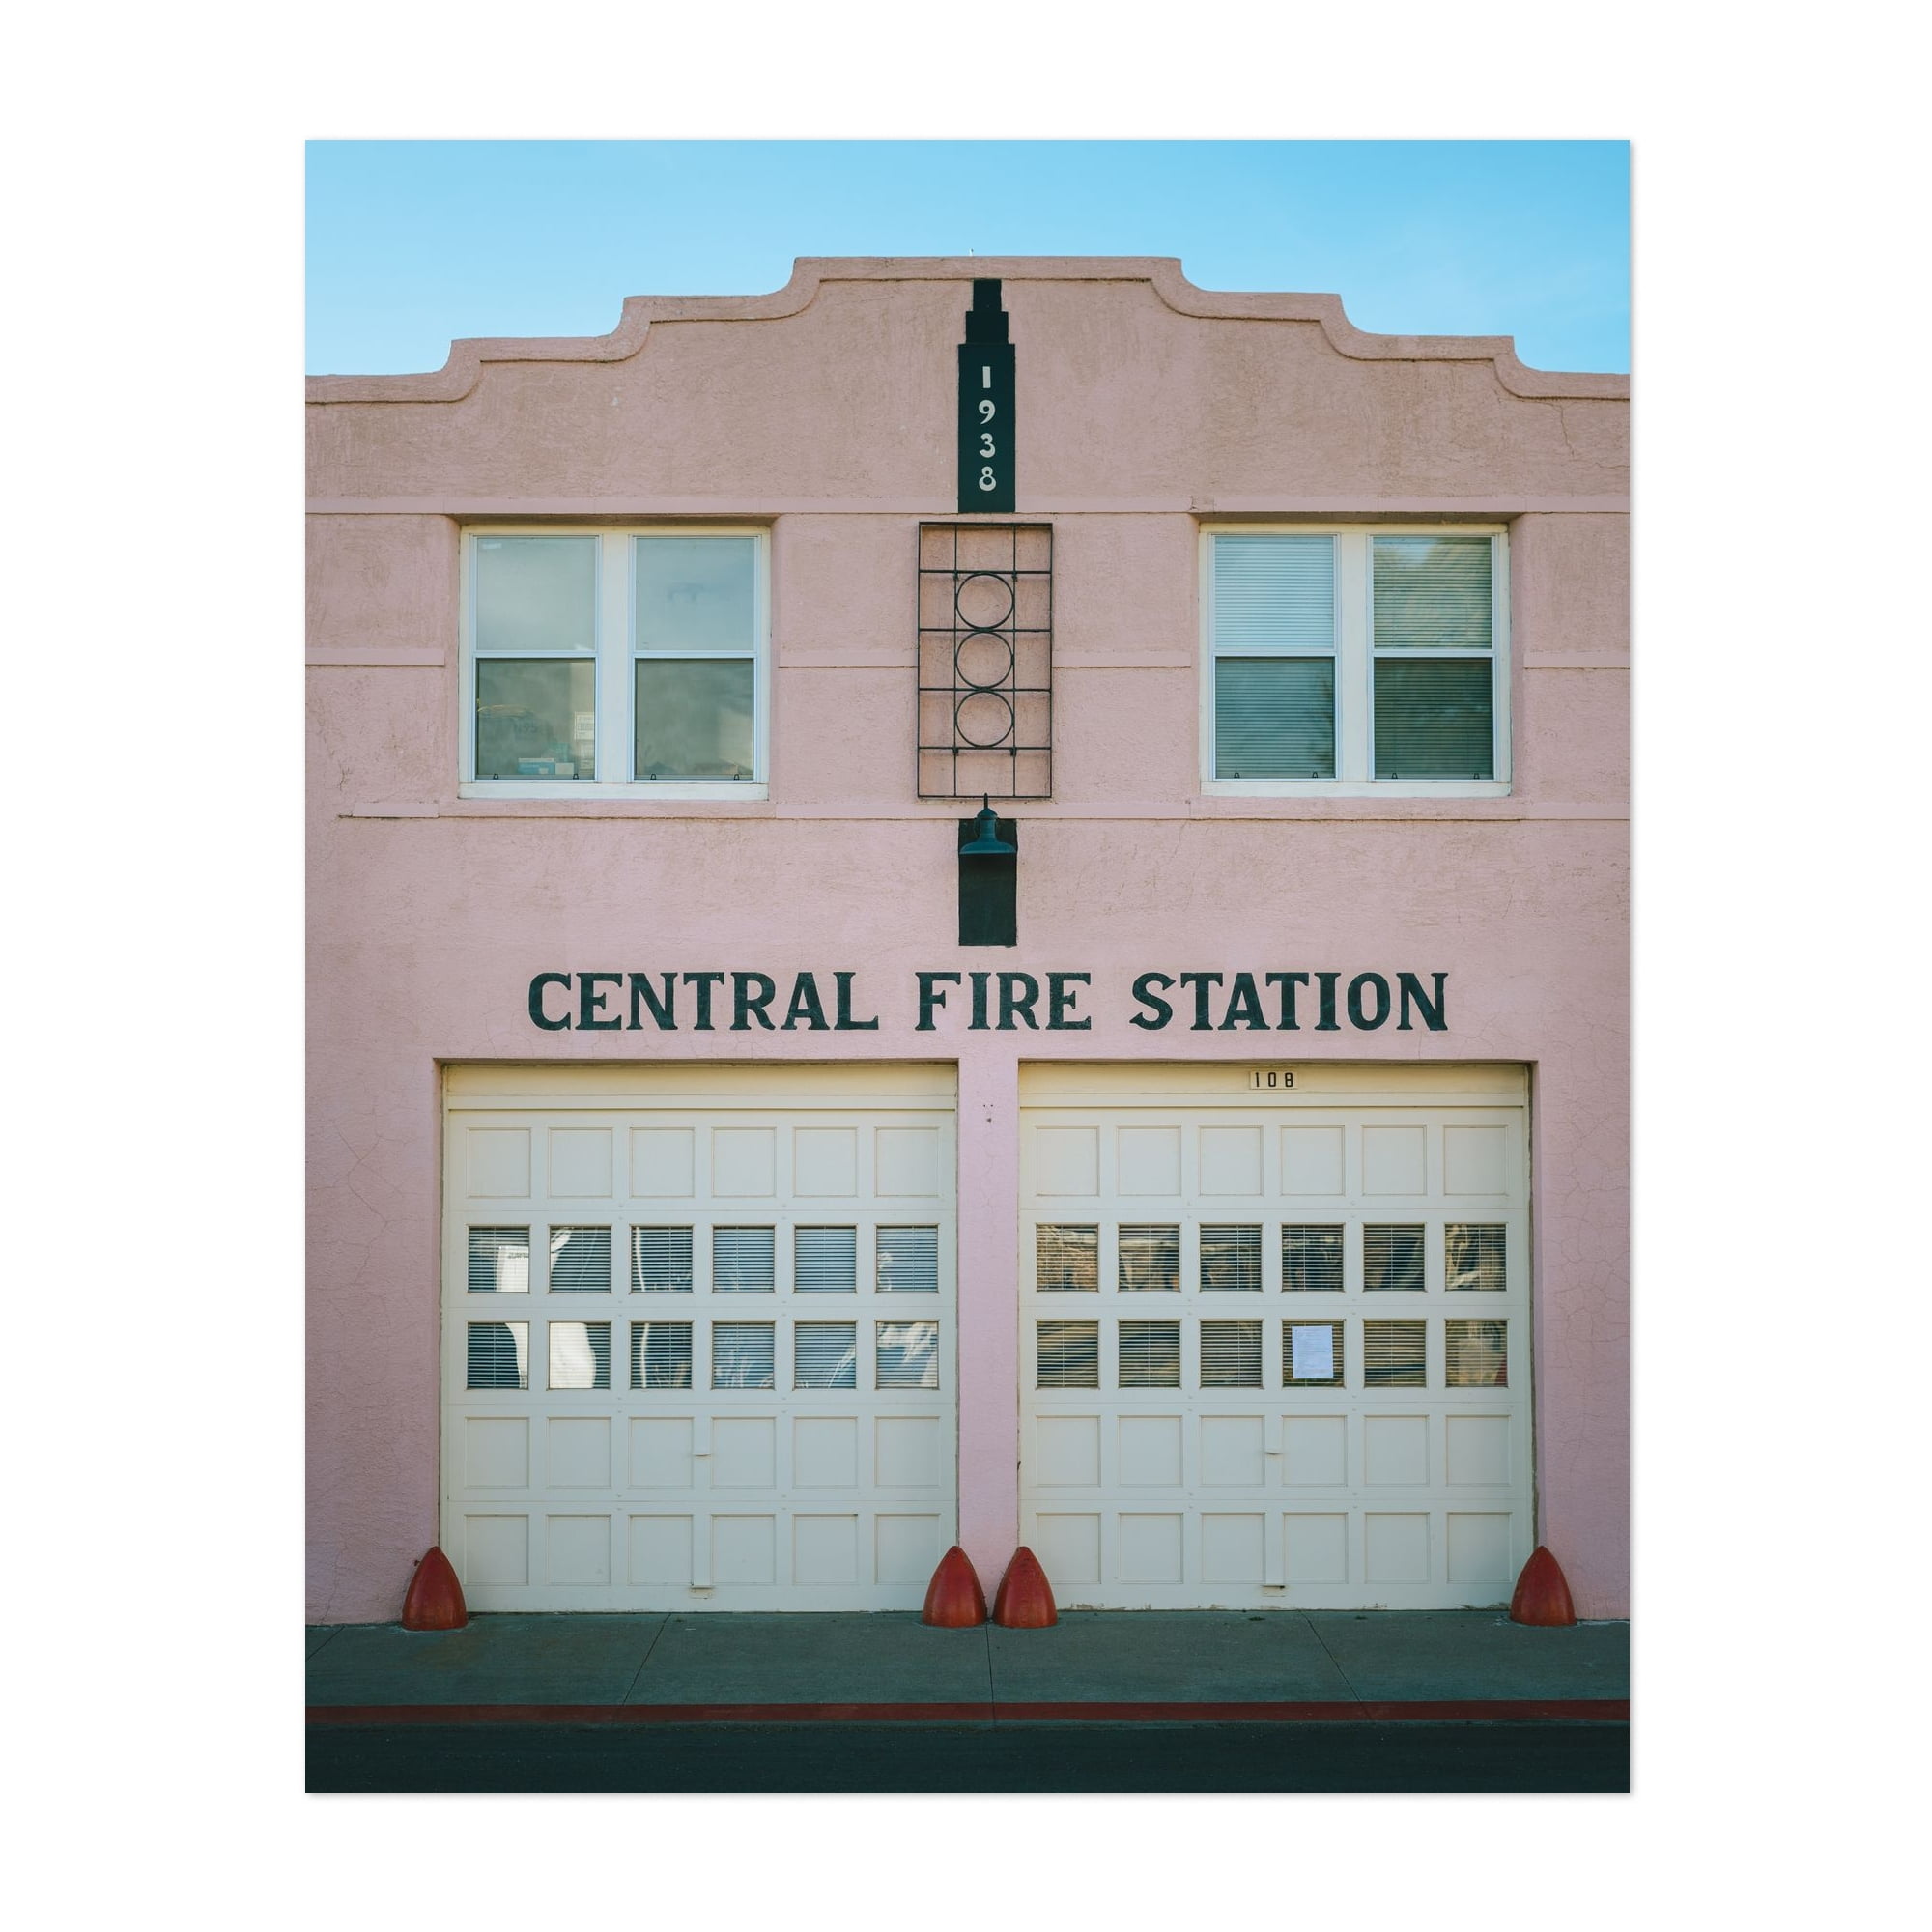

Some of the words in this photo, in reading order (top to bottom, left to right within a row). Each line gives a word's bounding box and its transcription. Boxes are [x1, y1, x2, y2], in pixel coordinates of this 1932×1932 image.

[978, 365, 997, 492] 1938
[528, 971, 880, 1031] CENTRAL
[914, 971, 1092, 1031] FIRE
[1129, 972, 1449, 1031] STATION
[1255, 1071, 1293, 1088] 108
